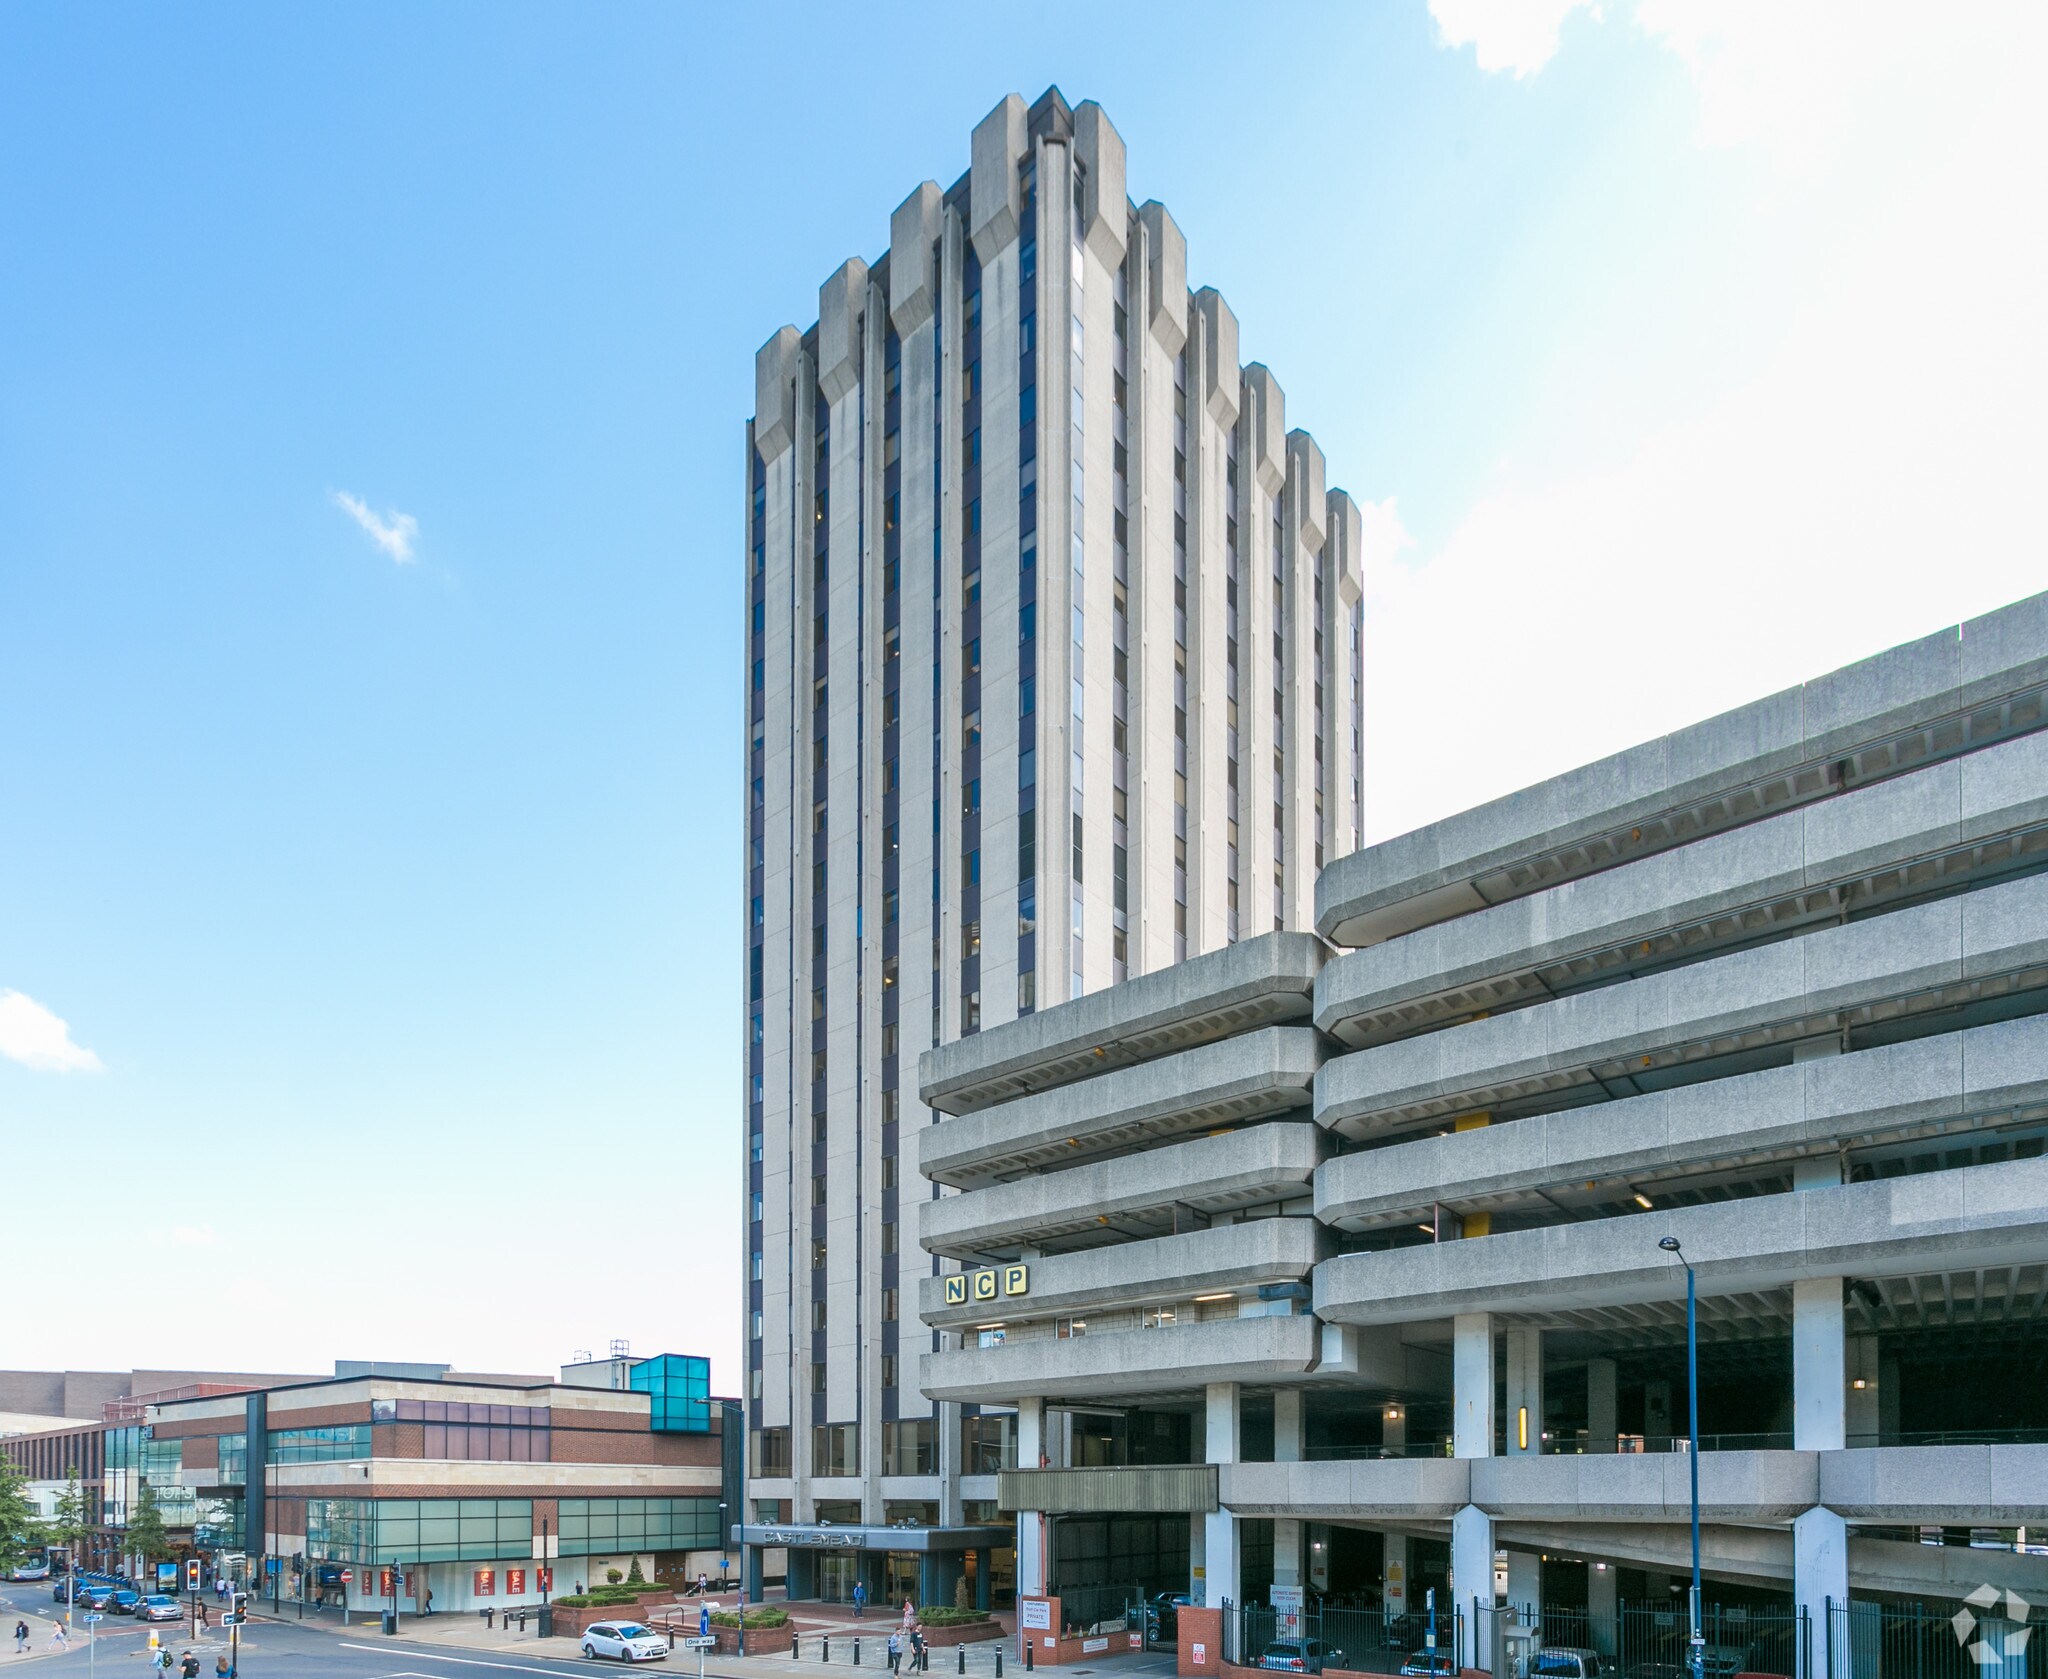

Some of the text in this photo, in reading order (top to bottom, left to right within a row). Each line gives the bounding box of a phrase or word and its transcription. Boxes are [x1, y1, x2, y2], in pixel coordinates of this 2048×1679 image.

[948, 1269, 1022, 1301] NCP
[152, 1487, 196, 1499] TOPS
[763, 1532, 865, 1547] CASTLEMEAD
[480, 1572, 489, 1595] SALE
[512, 1571, 520, 1593] SALE
